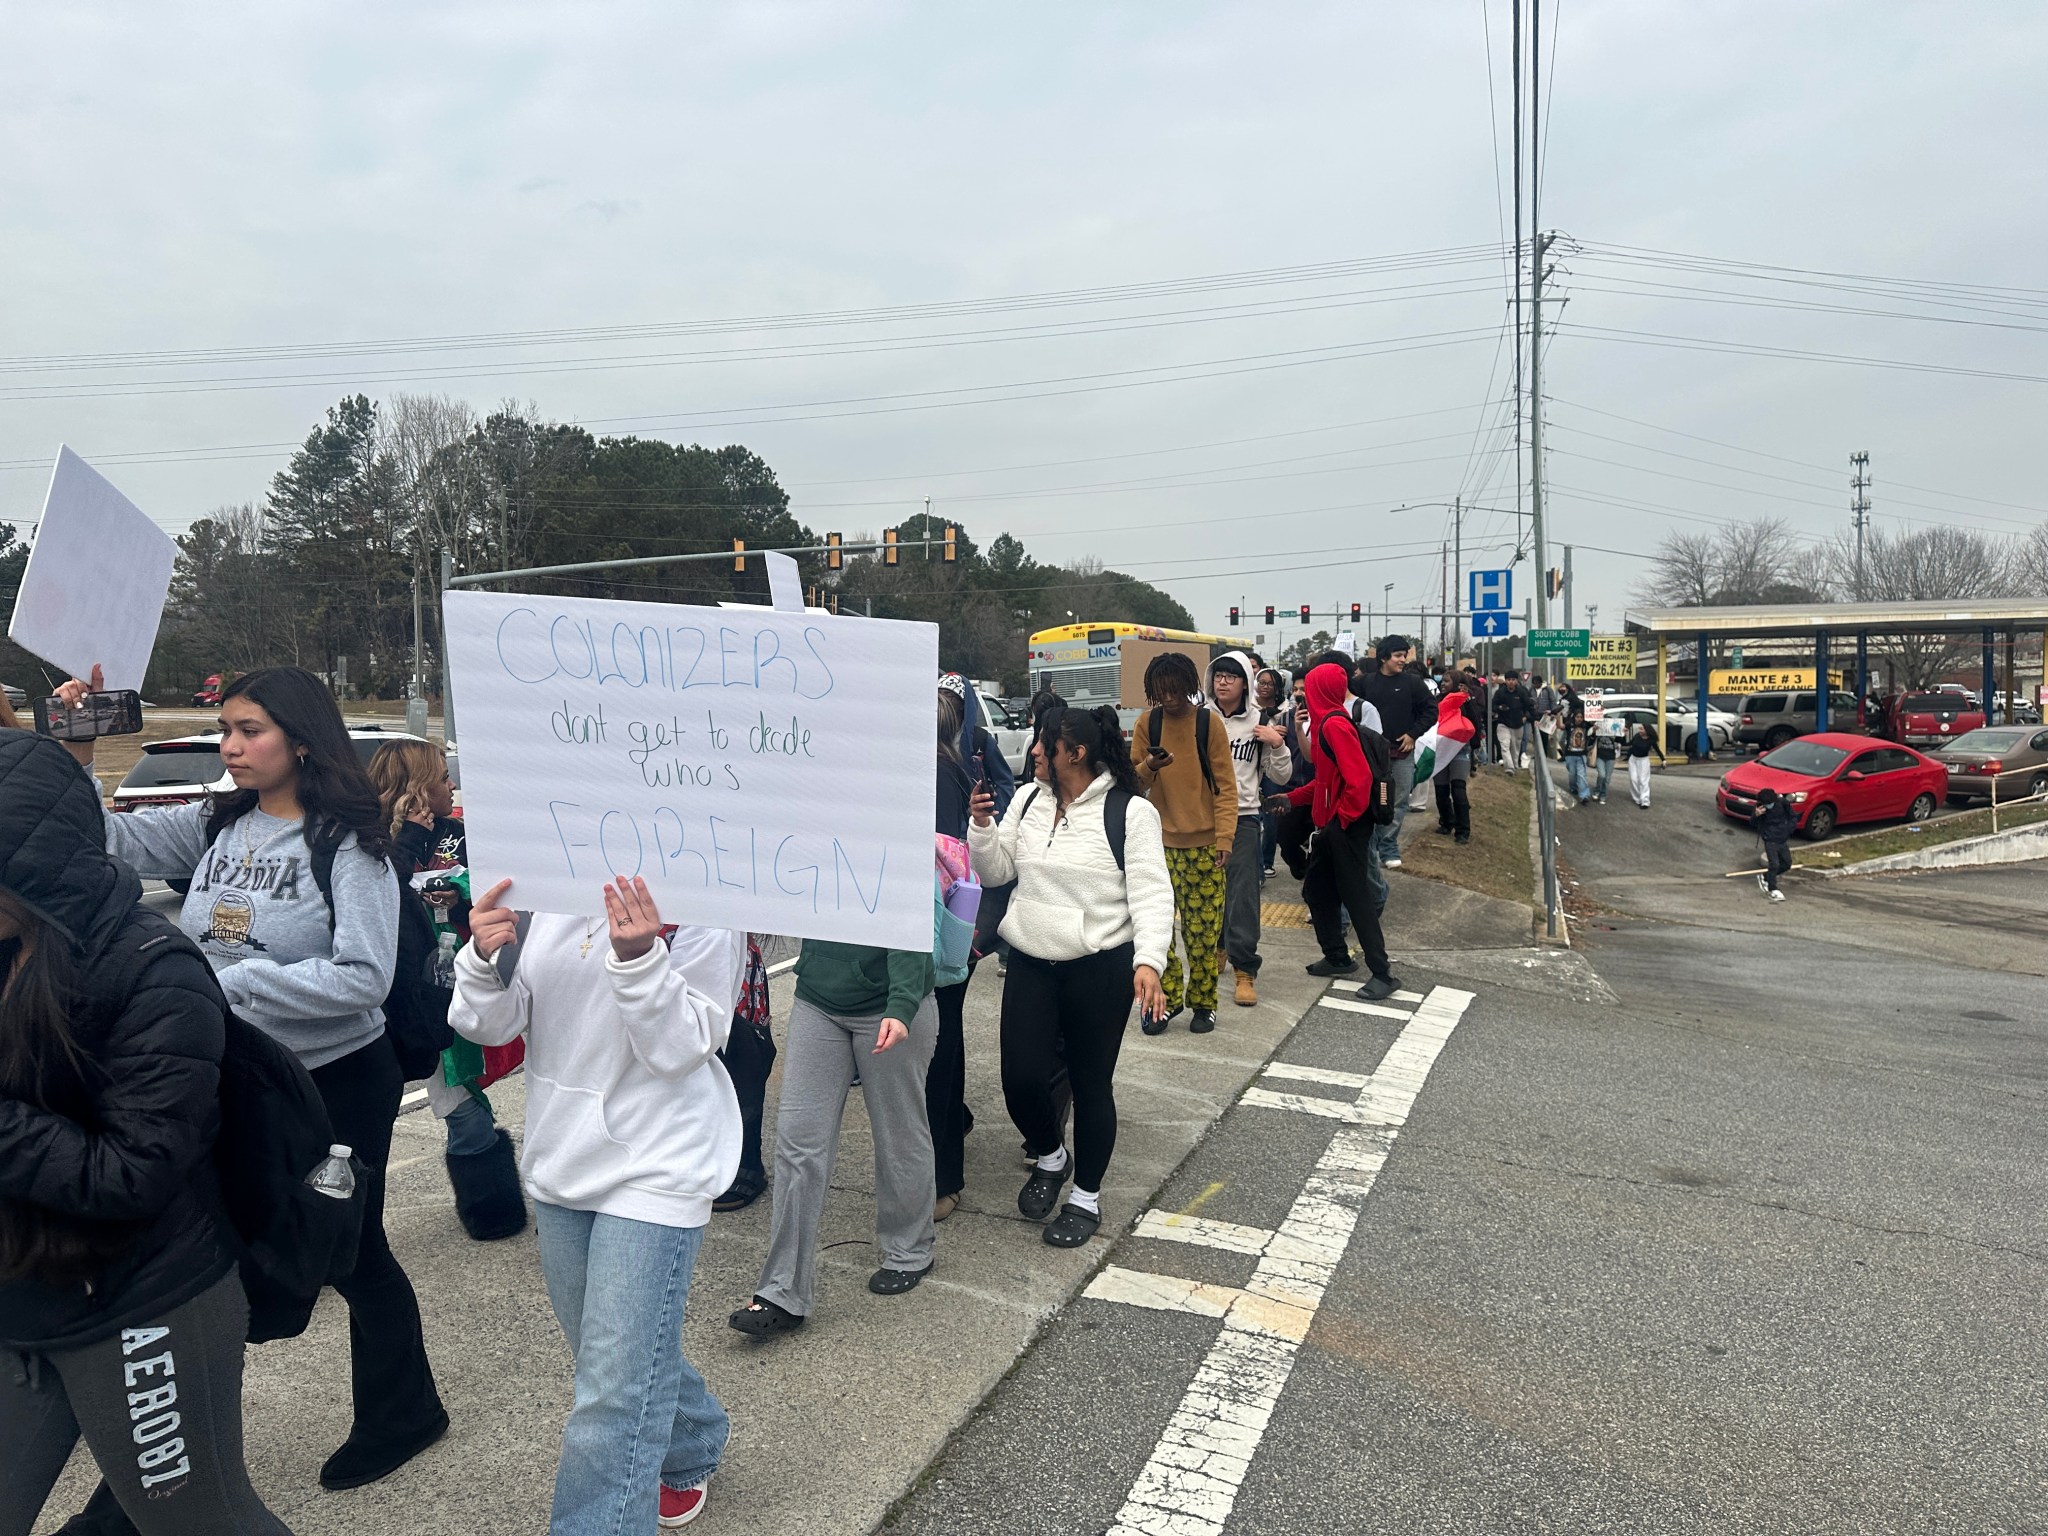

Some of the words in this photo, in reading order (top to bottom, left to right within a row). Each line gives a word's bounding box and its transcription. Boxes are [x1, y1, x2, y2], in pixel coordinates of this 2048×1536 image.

[1534, 630, 1558, 638] SOUTH
[1560, 630, 1580, 638] COBB
[1534, 639, 1552, 648] HIGH
[1554, 639, 1583, 648] SCHOOL
[1589, 640, 1615, 652] NTE
[1617, 640, 1633, 652] #3
[497, 608, 834, 700] COLONIZERS
[1570, 663, 1633, 677] 770.726.2174
[1728, 674, 1777, 684] MANTE
[1781, 674, 1790, 684] #
[1793, 674, 1803, 684] 3
[1585, 700, 1603, 708] OUR
[551, 699, 608, 746] dont
[627, 715, 686, 765] get
[707, 709, 729, 750] to
[749, 710, 816, 758] decide
[549, 800, 887, 914] FOREIGN
[193, 848, 302, 901] ARIZONA
[121, 1326, 191, 1489] AERO87
